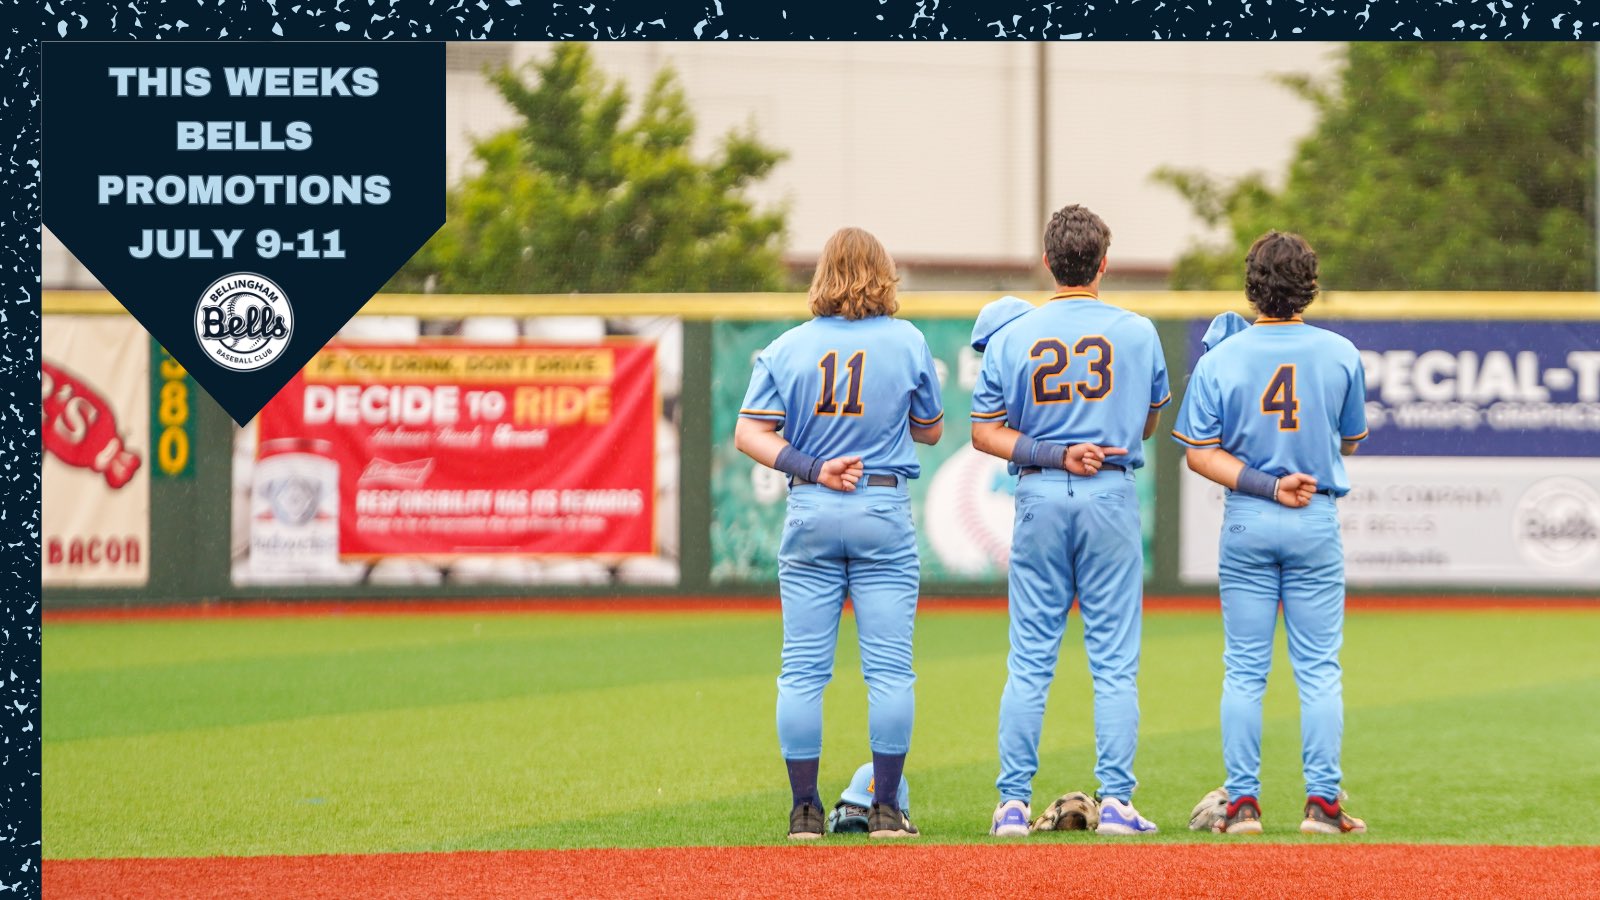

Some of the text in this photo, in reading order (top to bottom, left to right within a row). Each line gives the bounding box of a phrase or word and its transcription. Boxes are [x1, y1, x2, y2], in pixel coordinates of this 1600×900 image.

[814, 350, 866, 416] 11
[1030, 335, 1114, 405] 23
[1261, 363, 1300, 432] 4
[303, 385, 612, 425] DECIDE TO RIDE
[48, 538, 140, 565] BACON
